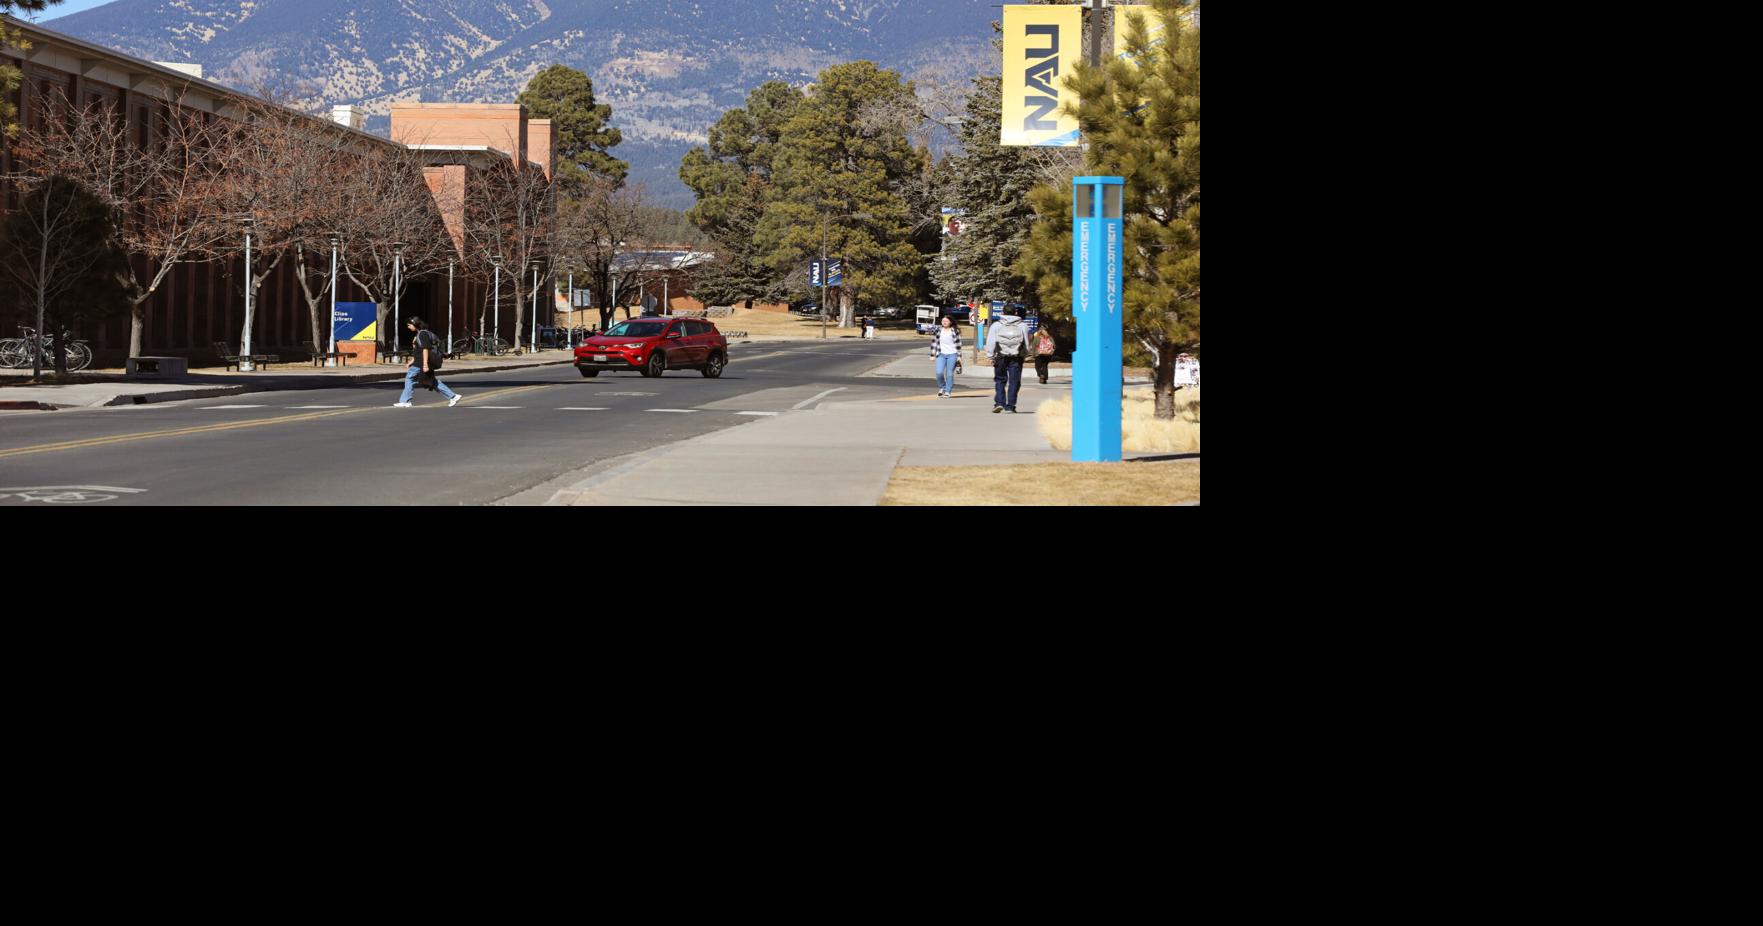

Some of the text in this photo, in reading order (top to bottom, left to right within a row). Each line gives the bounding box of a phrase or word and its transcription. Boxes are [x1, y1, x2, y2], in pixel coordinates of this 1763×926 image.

[1024, 24, 1059, 131] NAU
[812, 262, 820, 284] NAU
[1080, 221, 1090, 313] EMERGENCY
[1107, 223, 1117, 314] EMERGENCY
